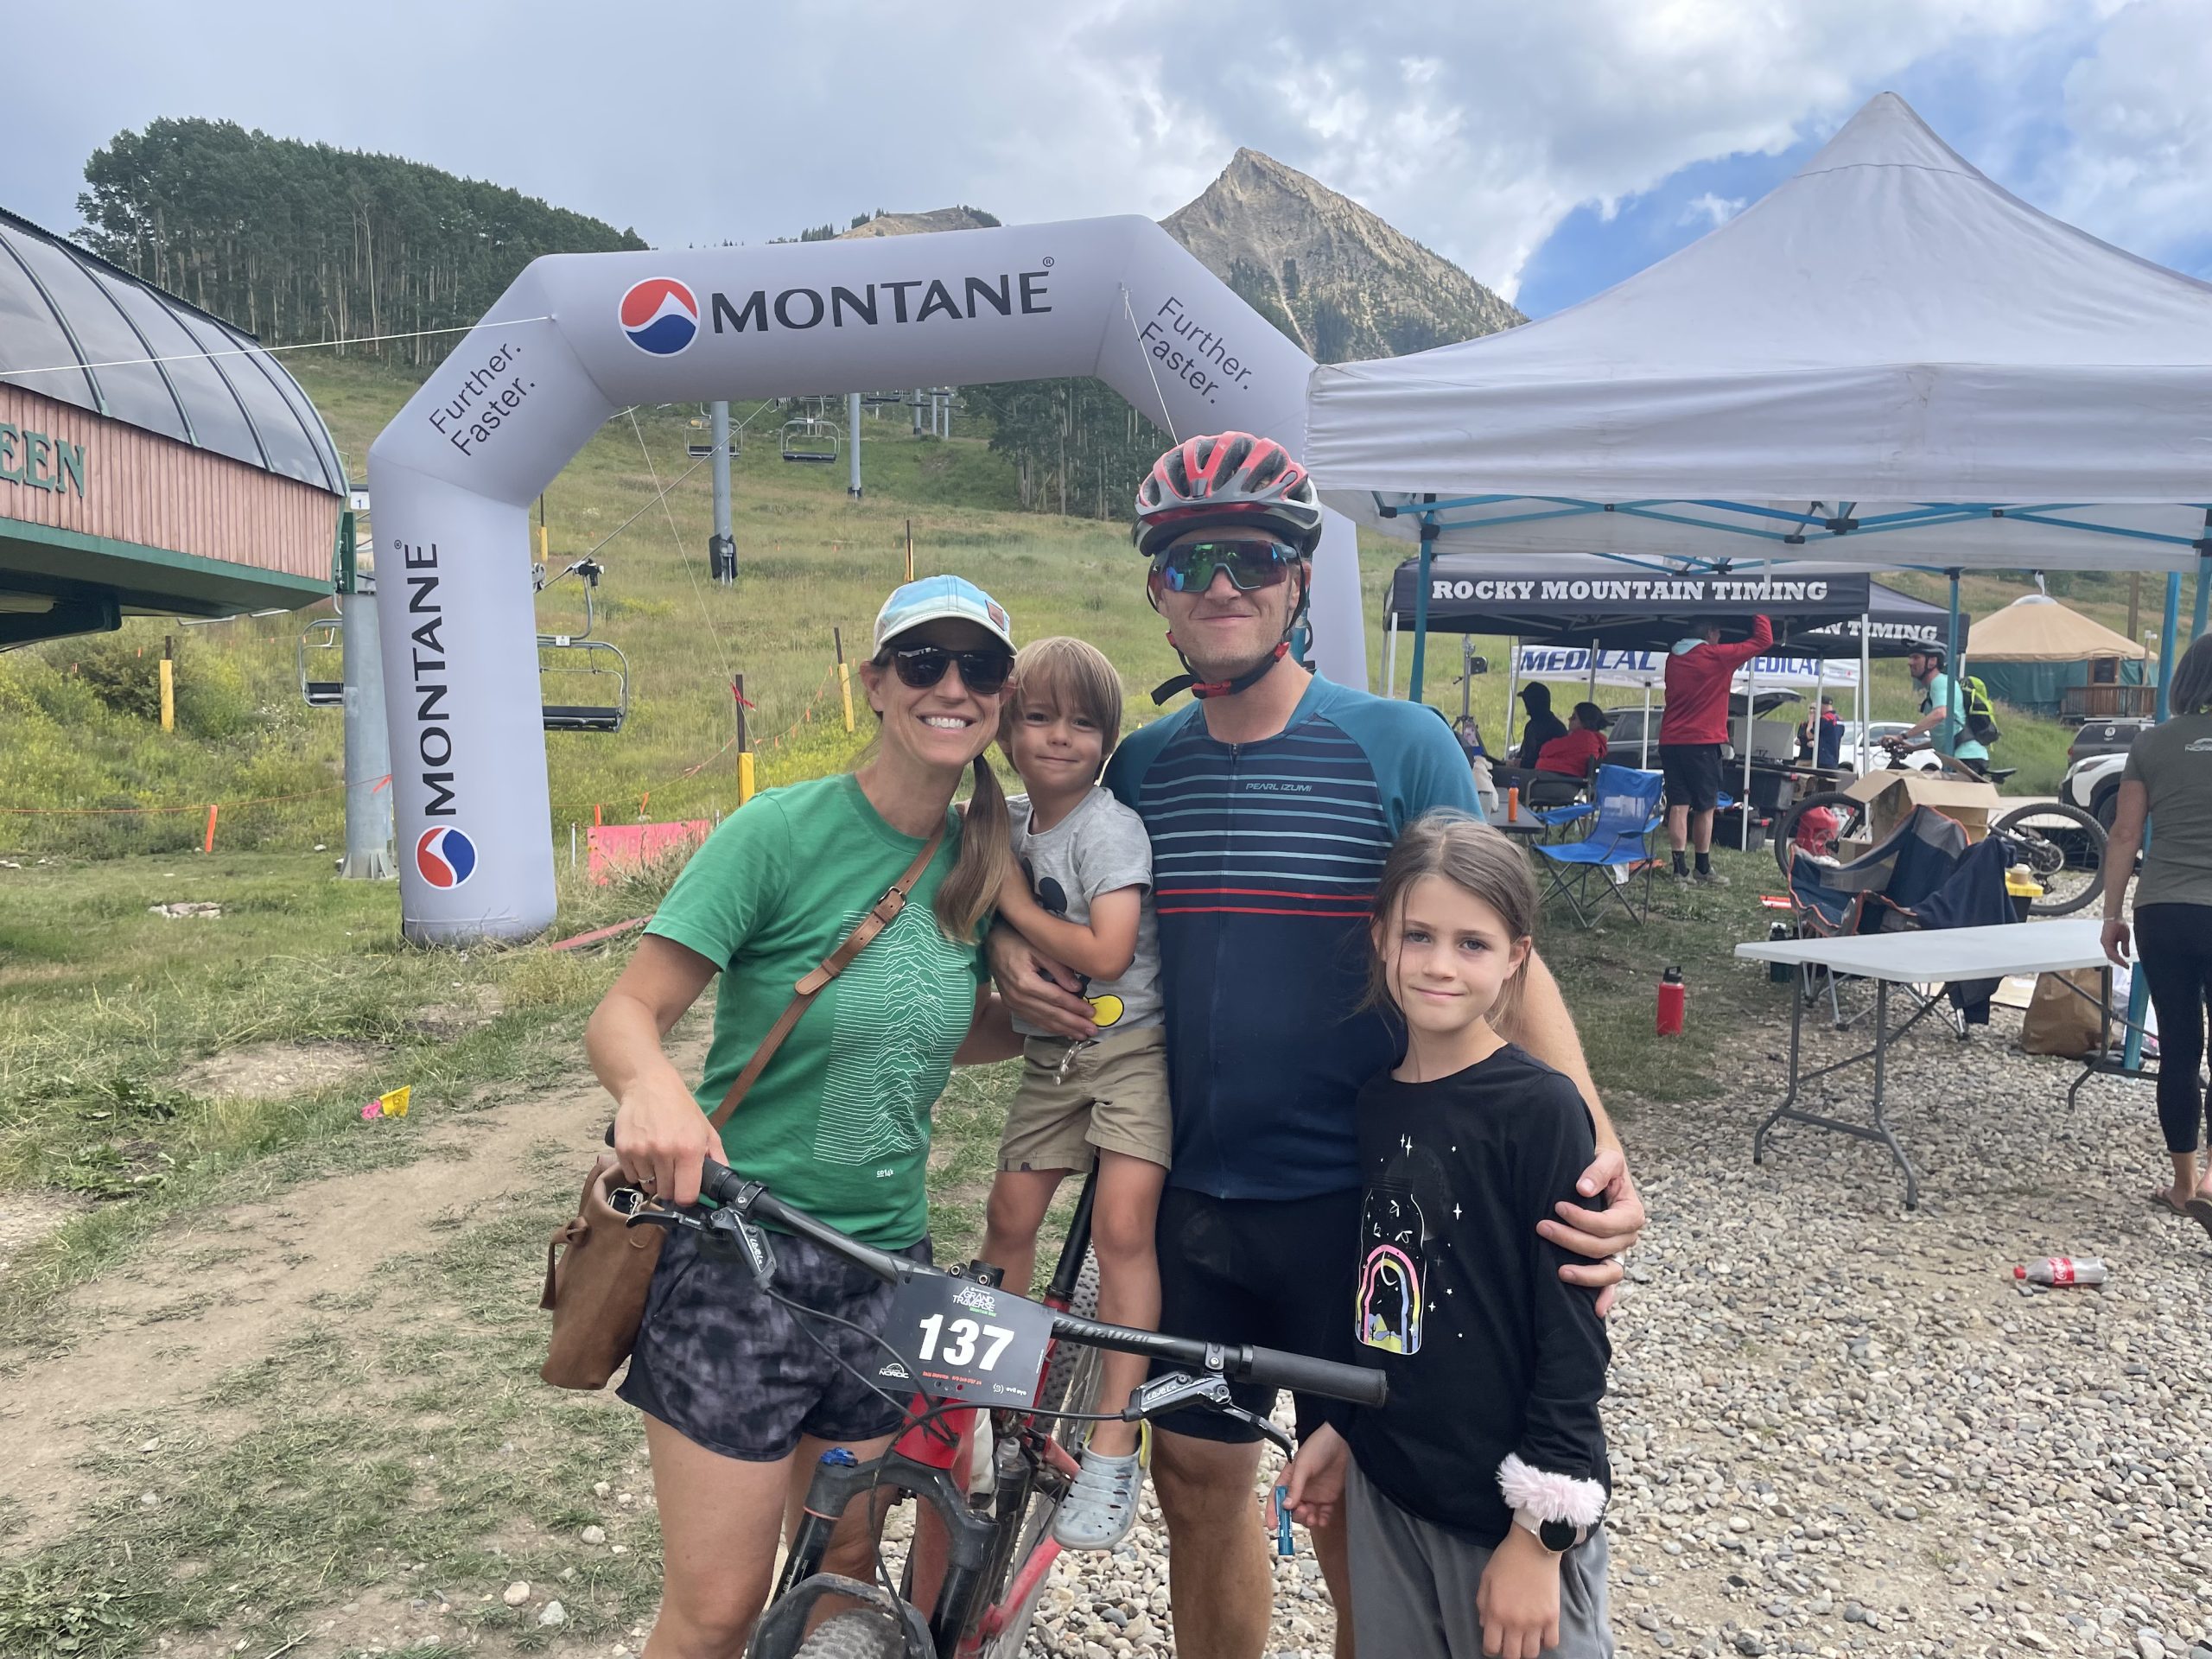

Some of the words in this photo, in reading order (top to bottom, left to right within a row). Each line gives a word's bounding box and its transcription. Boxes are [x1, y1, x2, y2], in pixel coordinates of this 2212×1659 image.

[711, 270, 1053, 334] MONTANE
[1137, 321, 1219, 404] Faster.
[1157, 296, 1252, 391] Further.
[429, 343, 521, 435] Further.
[450, 377, 536, 457] Faster.
[1432, 580, 1535, 601] ROCKY
[1541, 580, 1706, 601] MOUNTAIN
[1711, 581, 1828, 601] TIMING
[404, 543, 457, 817] MONTANE
[1280, 784, 1313, 792] IZUMI
[963, 1290, 995, 1305] GRAND
[879, 1368, 909, 1379] NORDIC
[918, 1313, 1015, 1371] 137
